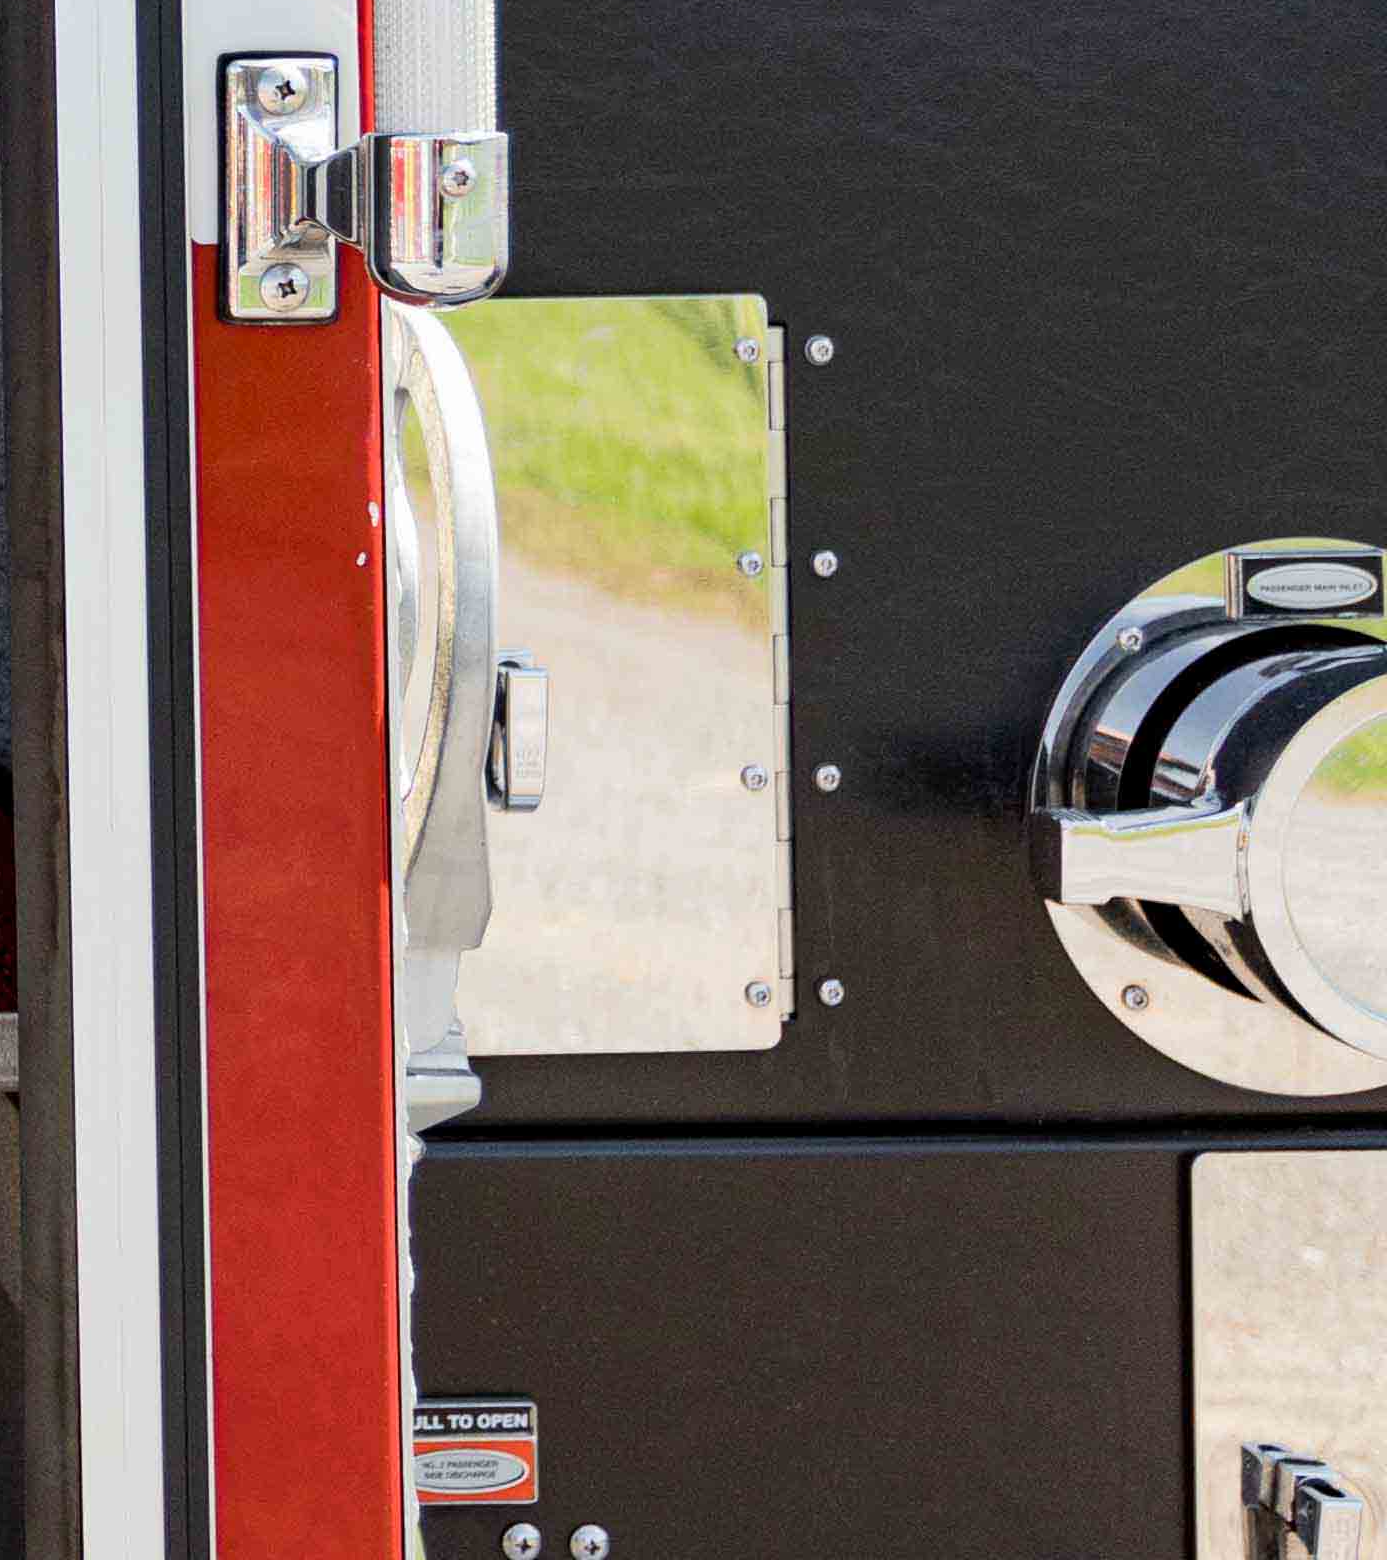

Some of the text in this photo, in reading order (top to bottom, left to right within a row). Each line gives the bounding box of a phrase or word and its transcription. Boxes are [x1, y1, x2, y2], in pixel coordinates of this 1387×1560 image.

[413, 1413, 528, 1430] ULL TO OPEN
